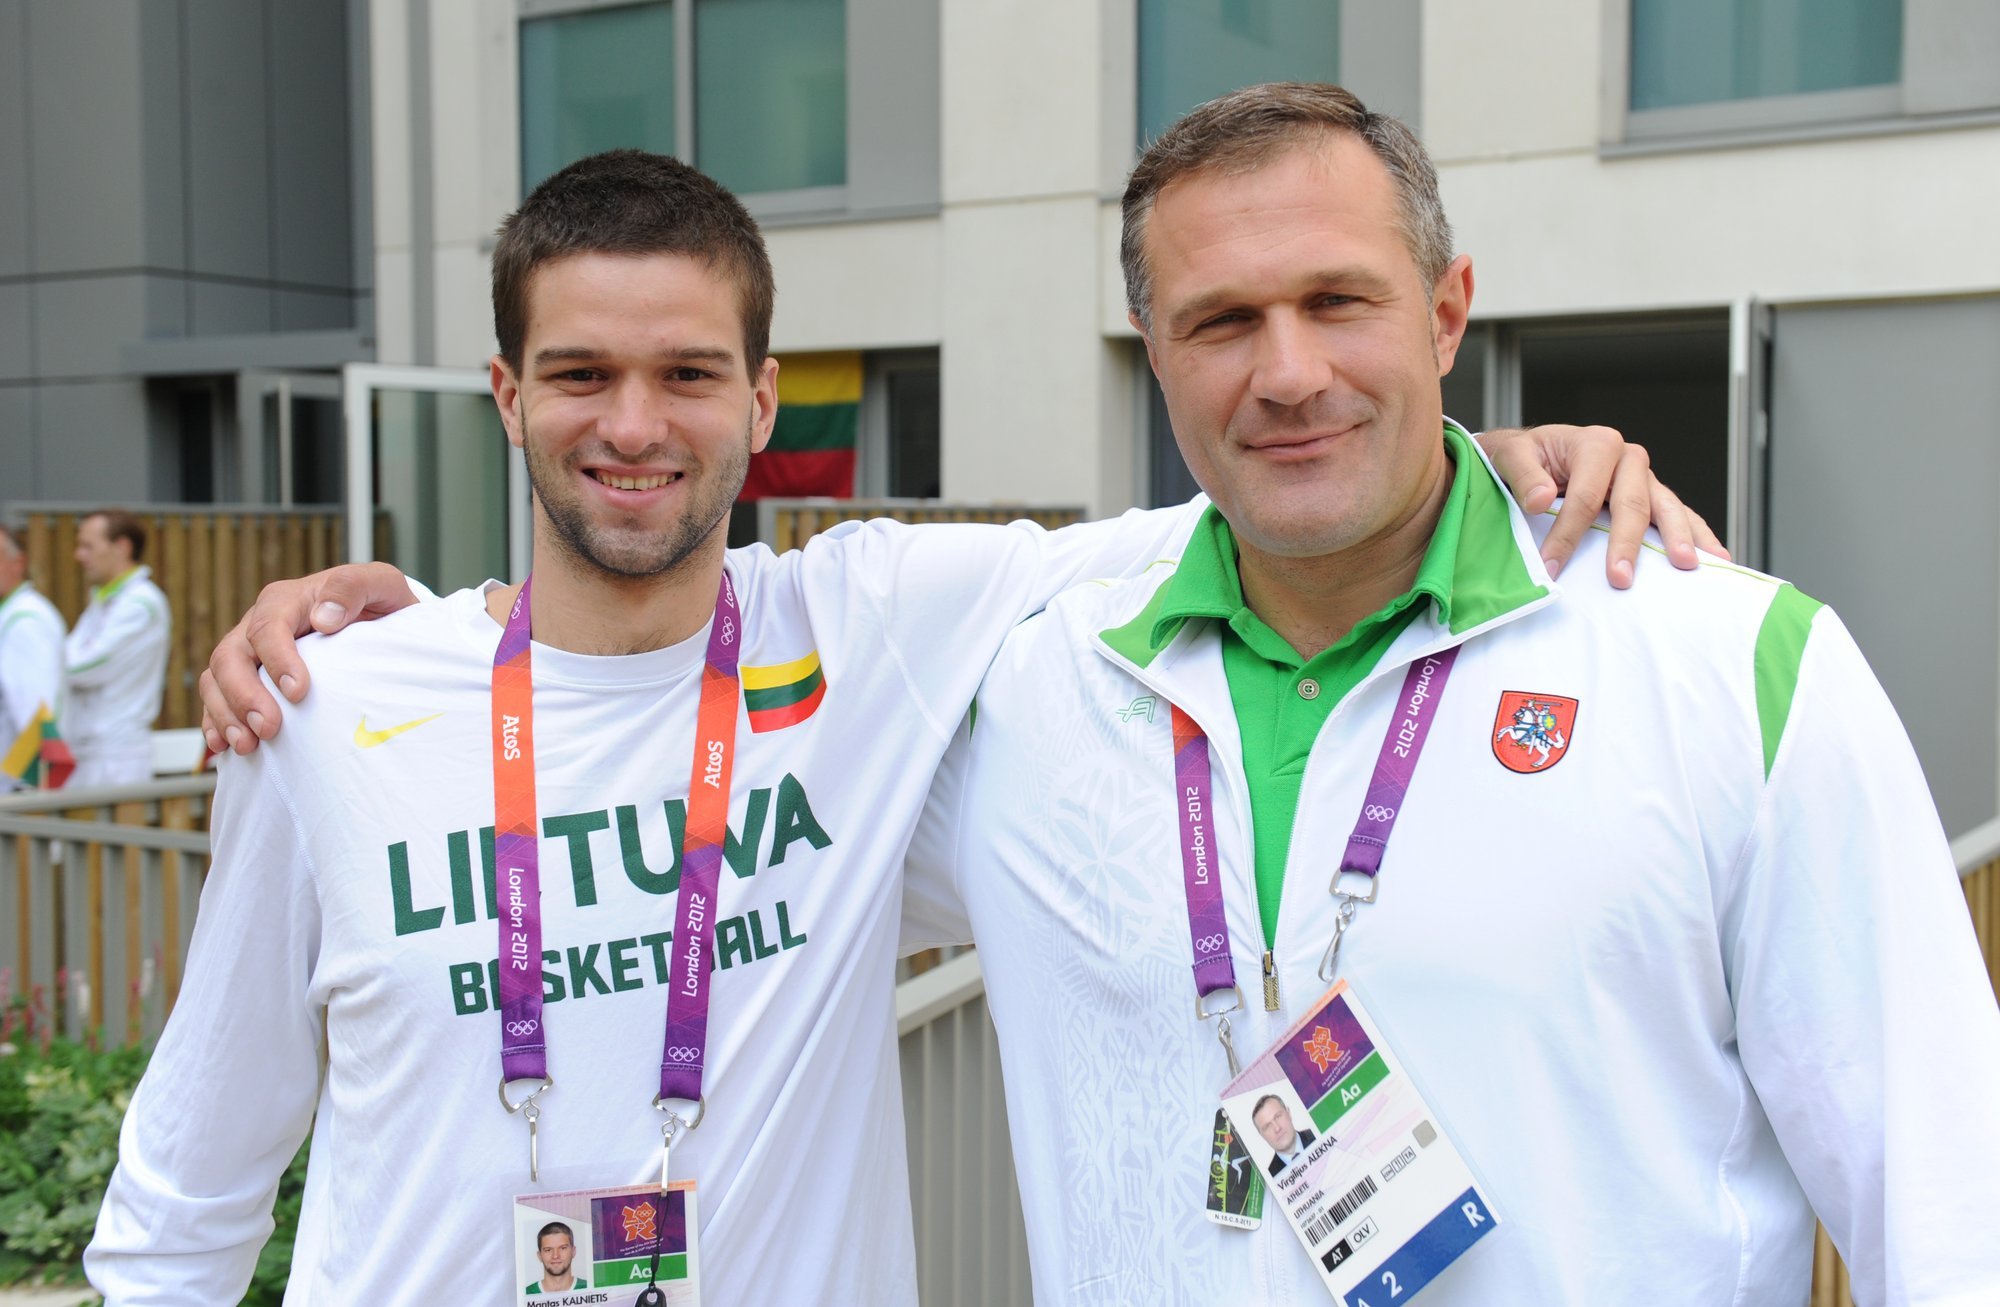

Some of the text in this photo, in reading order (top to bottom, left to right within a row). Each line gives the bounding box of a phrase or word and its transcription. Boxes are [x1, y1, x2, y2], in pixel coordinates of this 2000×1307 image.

[1393, 657, 1442, 758] London 2012
[502, 714, 521, 761] Atos
[703, 740, 725, 789] Atos
[387, 772, 834, 937] LITUVA
[1186, 786, 1209, 885] London 2012
[508, 867, 528, 971] London 2012
[681, 893, 706, 998] London 2012
[448, 900, 808, 1016] BSKETALL
[1340, 1083, 1362, 1107] Aa
[1276, 1135, 1338, 1190] Virgilijus ALEKNA
[1286, 1180, 1310, 1205] ATHLETE
[1293, 1189, 1326, 1219] LITHUANIA
[1331, 1224, 1371, 1265] AT OLV
[1381, 1201, 1486, 1299] 2 R
[562, 1293, 609, 1307] KALNIETIS
